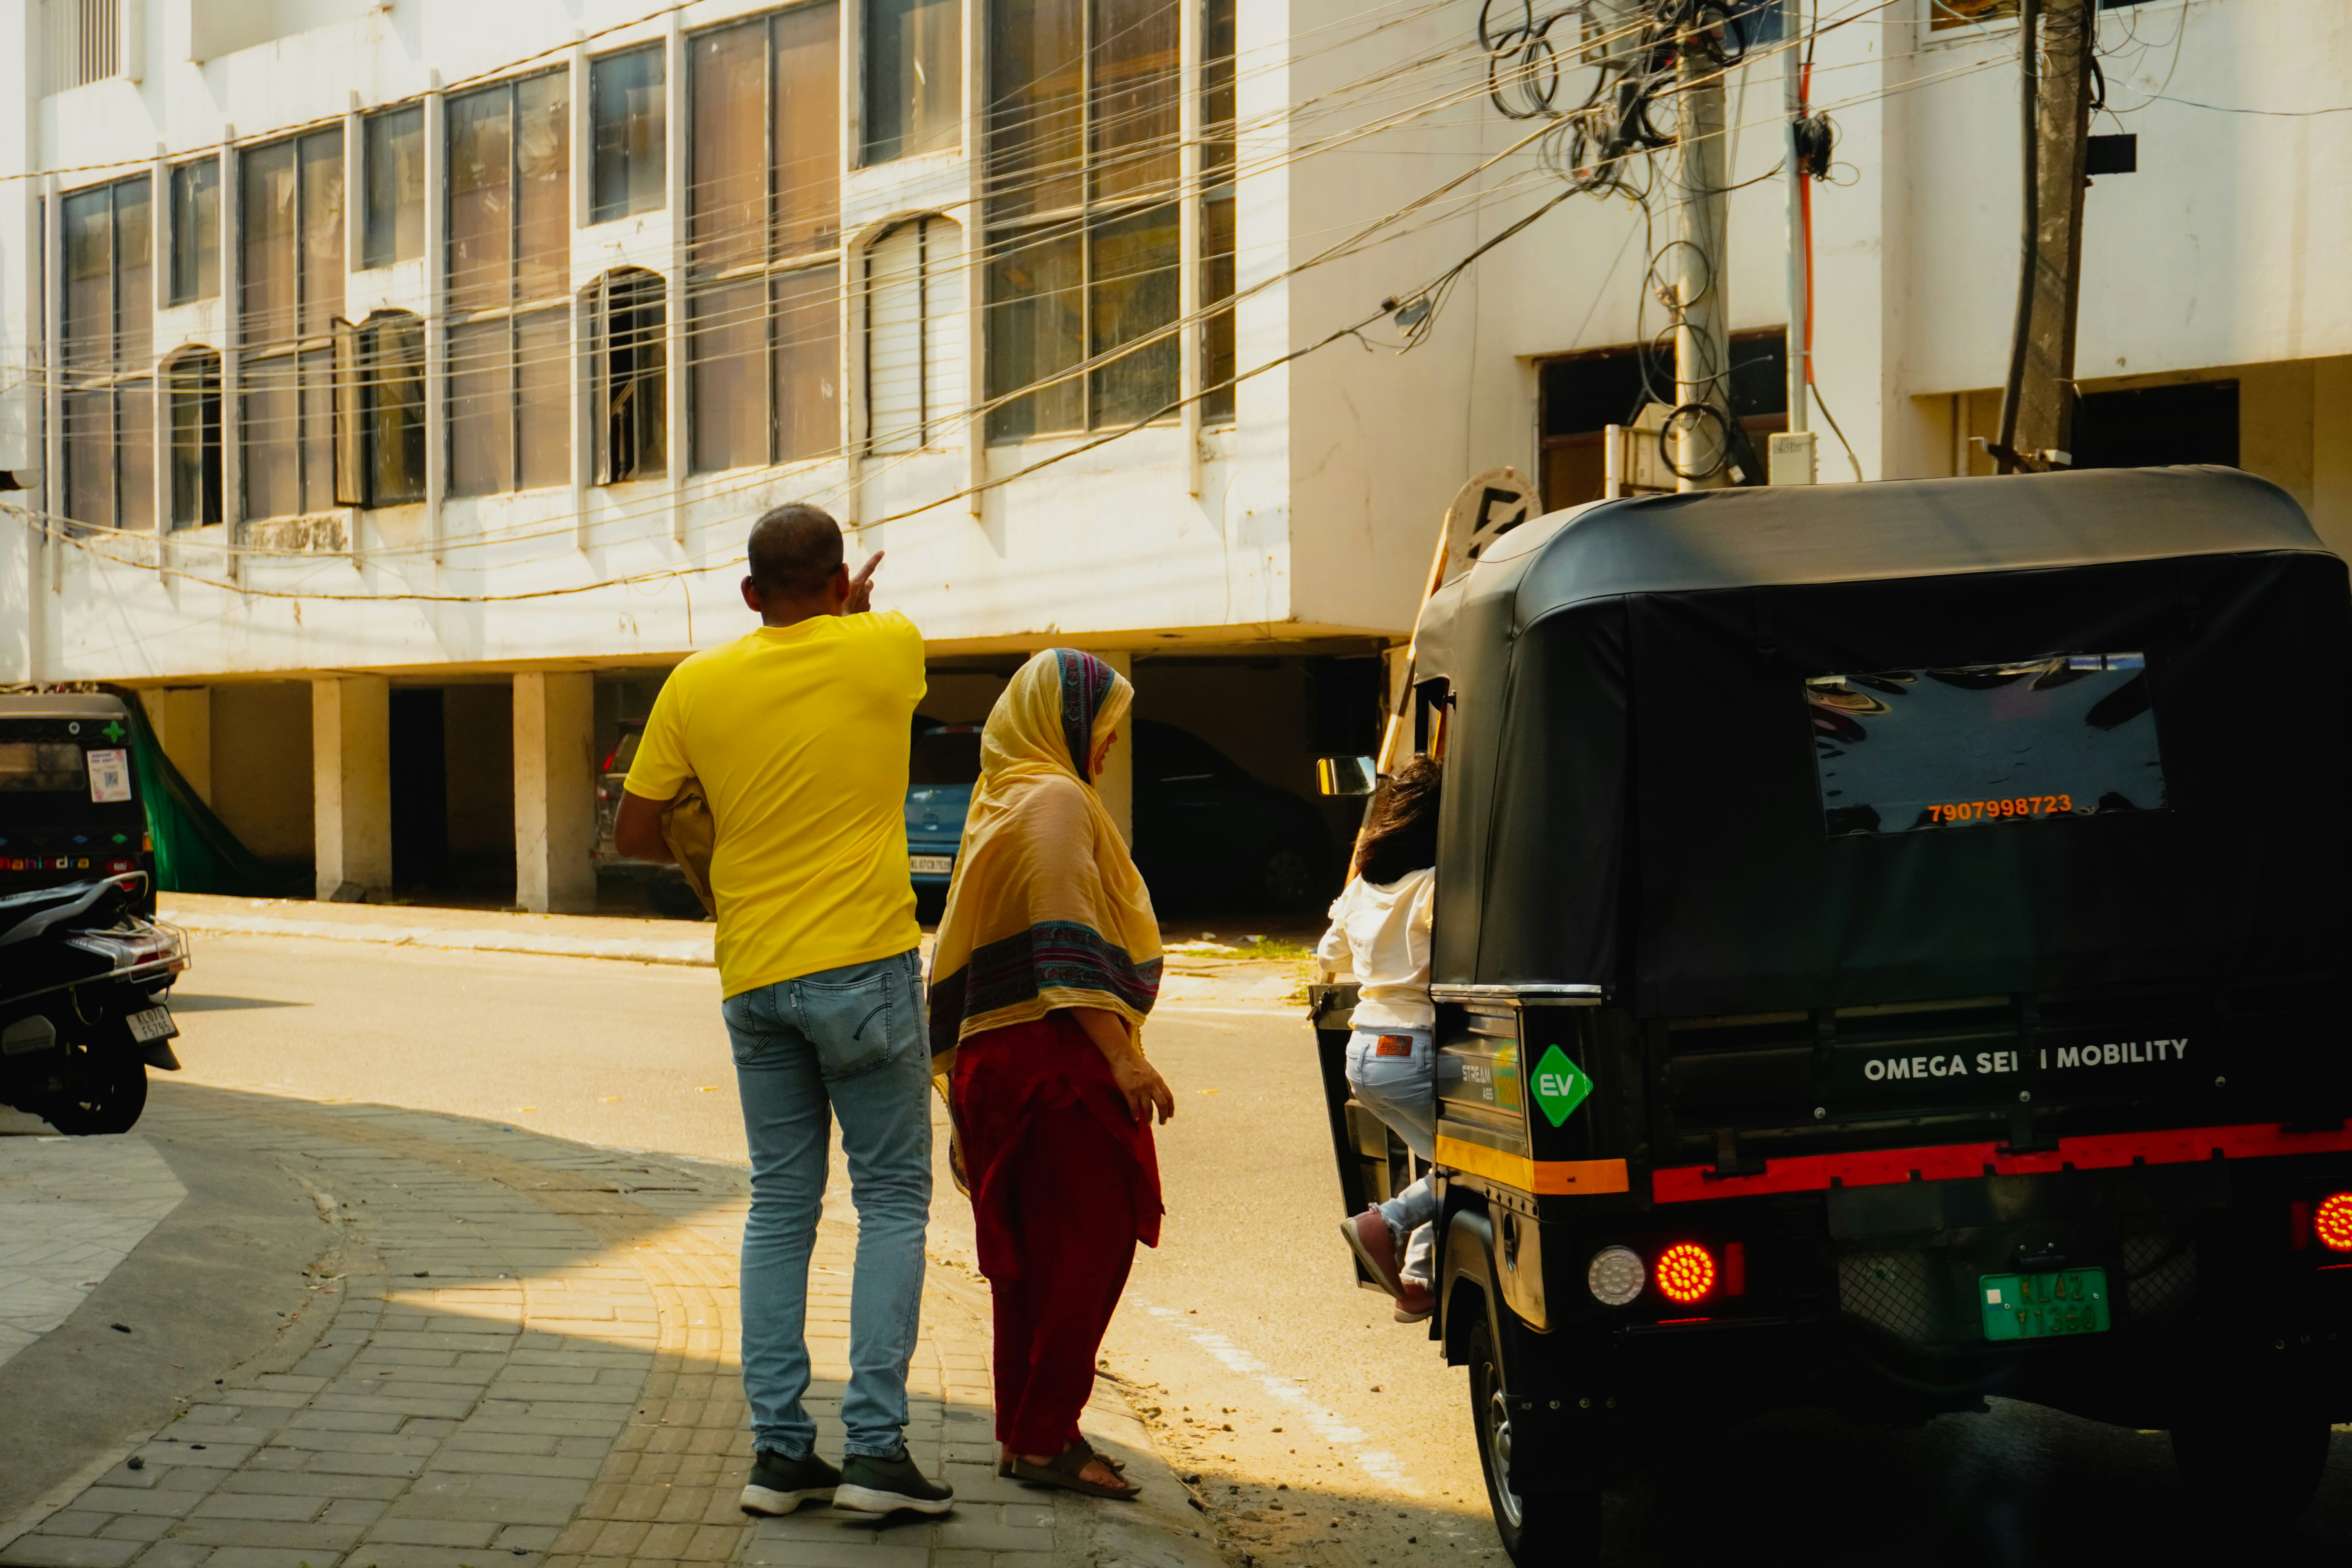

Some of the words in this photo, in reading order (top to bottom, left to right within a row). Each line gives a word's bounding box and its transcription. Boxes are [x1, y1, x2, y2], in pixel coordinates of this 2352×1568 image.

[1928, 795, 2072, 822] 7907998723
[1864, 1055, 1968, 1080] OMEGA
[1976, 1049, 2047, 1073] SEII
[2057, 1038, 2188, 1068] MOBILITY
[1462, 1065, 1492, 1084] STREAM
[1540, 1074, 1574, 1096] EV
